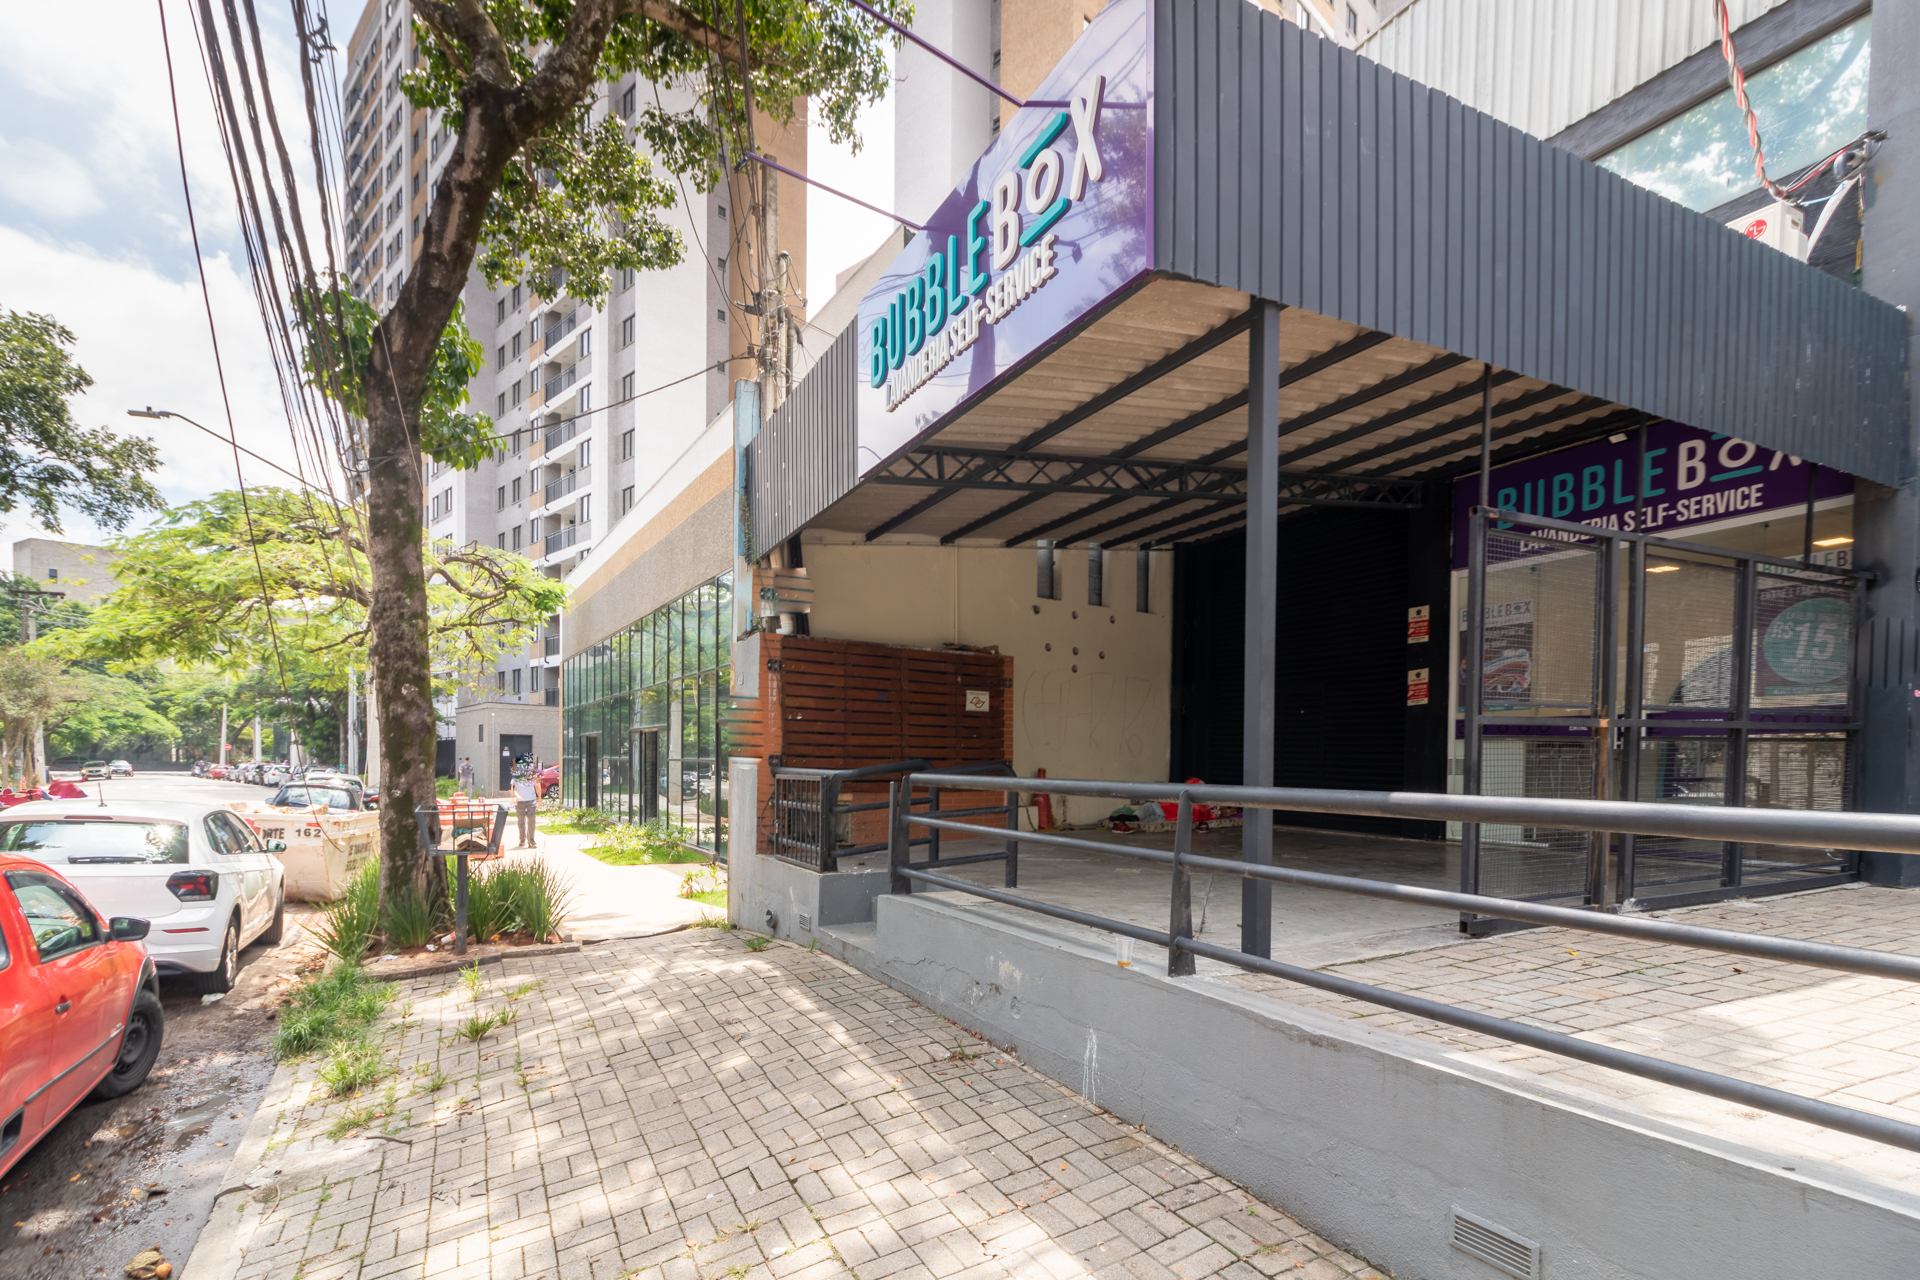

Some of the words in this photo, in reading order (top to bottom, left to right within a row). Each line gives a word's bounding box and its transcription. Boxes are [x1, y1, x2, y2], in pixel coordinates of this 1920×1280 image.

[870, 200, 988, 388] BUBBLE
[993, 74, 1106, 269] BOX
[886, 330, 951, 412] LAVANDERIA
[950, 233, 1057, 356] SELF-SERVICE
[1497, 447, 1668, 530] BUBBLE
[1623, 483, 1765, 532] SELF-SERVICE
[295, 828, 321, 838] 162
